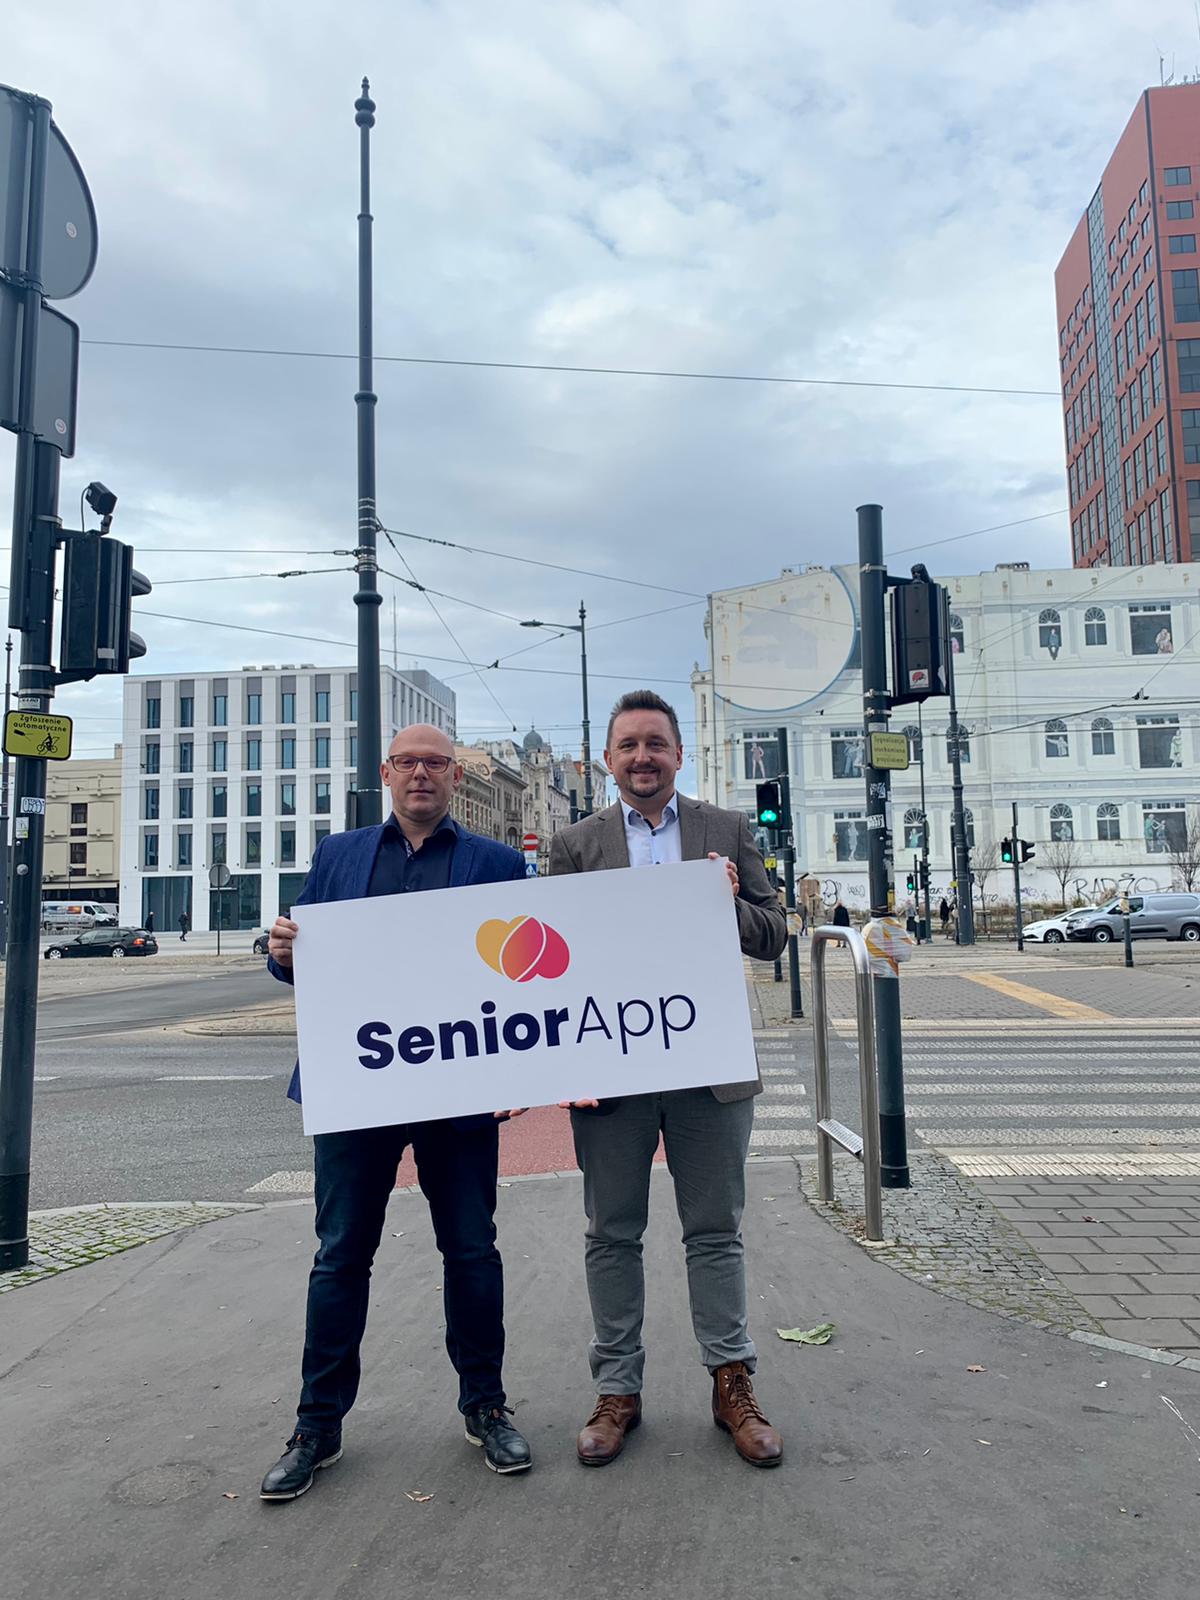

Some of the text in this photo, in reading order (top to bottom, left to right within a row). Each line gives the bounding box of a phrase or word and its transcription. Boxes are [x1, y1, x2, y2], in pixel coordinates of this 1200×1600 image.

[20, 714, 61, 725] Zgłoszenie
[13, 722, 67, 732] automatyczne
[357, 994, 696, 1069] SeniorApp
